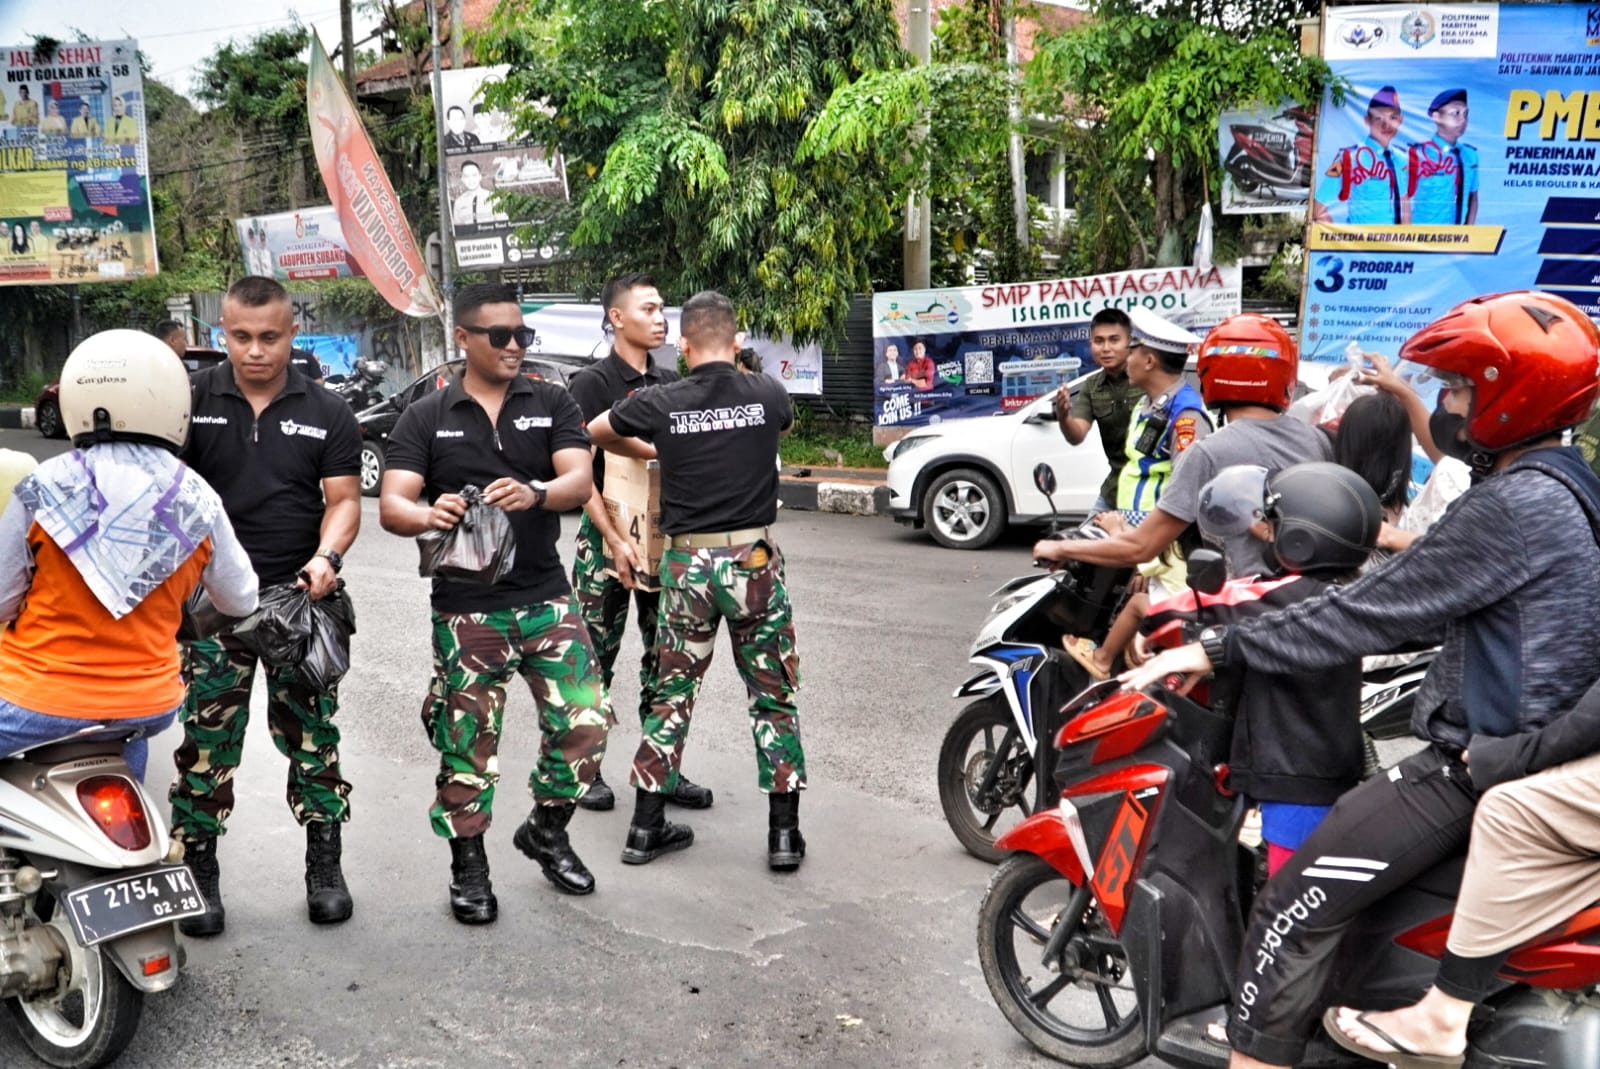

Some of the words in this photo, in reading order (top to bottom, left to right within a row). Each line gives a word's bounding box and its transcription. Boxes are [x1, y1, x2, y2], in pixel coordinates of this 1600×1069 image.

[1459, 30, 1488, 38] UTAMA
[57, 47, 102, 65] SEHAT
[1500, 53, 1552, 63] POLITEKNIK
[1554, 53, 1592, 63] MARITIM
[7, 69, 32, 82] HUT
[34, 66, 84, 81] GOLKAR
[86, 65, 102, 78] KE
[112, 64, 130, 77] 58
[1498, 64, 1521, 75] SATU
[1530, 64, 1572, 75] SATUNYA
[1574, 65, 1584, 75] DI
[0, 147, 34, 171] LKAR
[1505, 147, 1596, 161] PENERIMAAN
[1503, 180, 1534, 188] KELAS
[1535, 180, 1579, 189] REGULER
[1580, 181, 1587, 189] &
[1320, 232, 1364, 242] TERSEDIA
[1367, 232, 1416, 242] BERBAGAI
[1417, 233, 1470, 243] BEASISWA
[279, 252, 316, 268] KABUPATEN
[316, 249, 346, 264] SUBANG
[1314, 255, 1345, 293] 3
[1348, 260, 1414, 275] PROGRAM
[981, 285, 1031, 308] SMP
[1039, 265, 1224, 304] PANATAGAMA
[1347, 278, 1388, 291] STUDI
[1012, 300, 1092, 323] ISLAMIC
[1103, 293, 1188, 312] SCHOOL
[1339, 305, 1407, 314] TRANSPORTASI
[1408, 307, 1433, 315] LAUT
[981, 332, 1059, 348] PENERIMAAN
[1024, 346, 1059, 357] BARU
[76, 375, 127, 385] Cargloss
[883, 393, 910, 413] COME
[669, 403, 765, 427] TRABAS
[878, 410, 899, 426] JOIN
[899, 406, 912, 421] US
[73, 758, 108, 768] HONDA
[76, 893, 92, 917] T
[103, 877, 160, 910] 2754
[164, 871, 192, 894] VK
